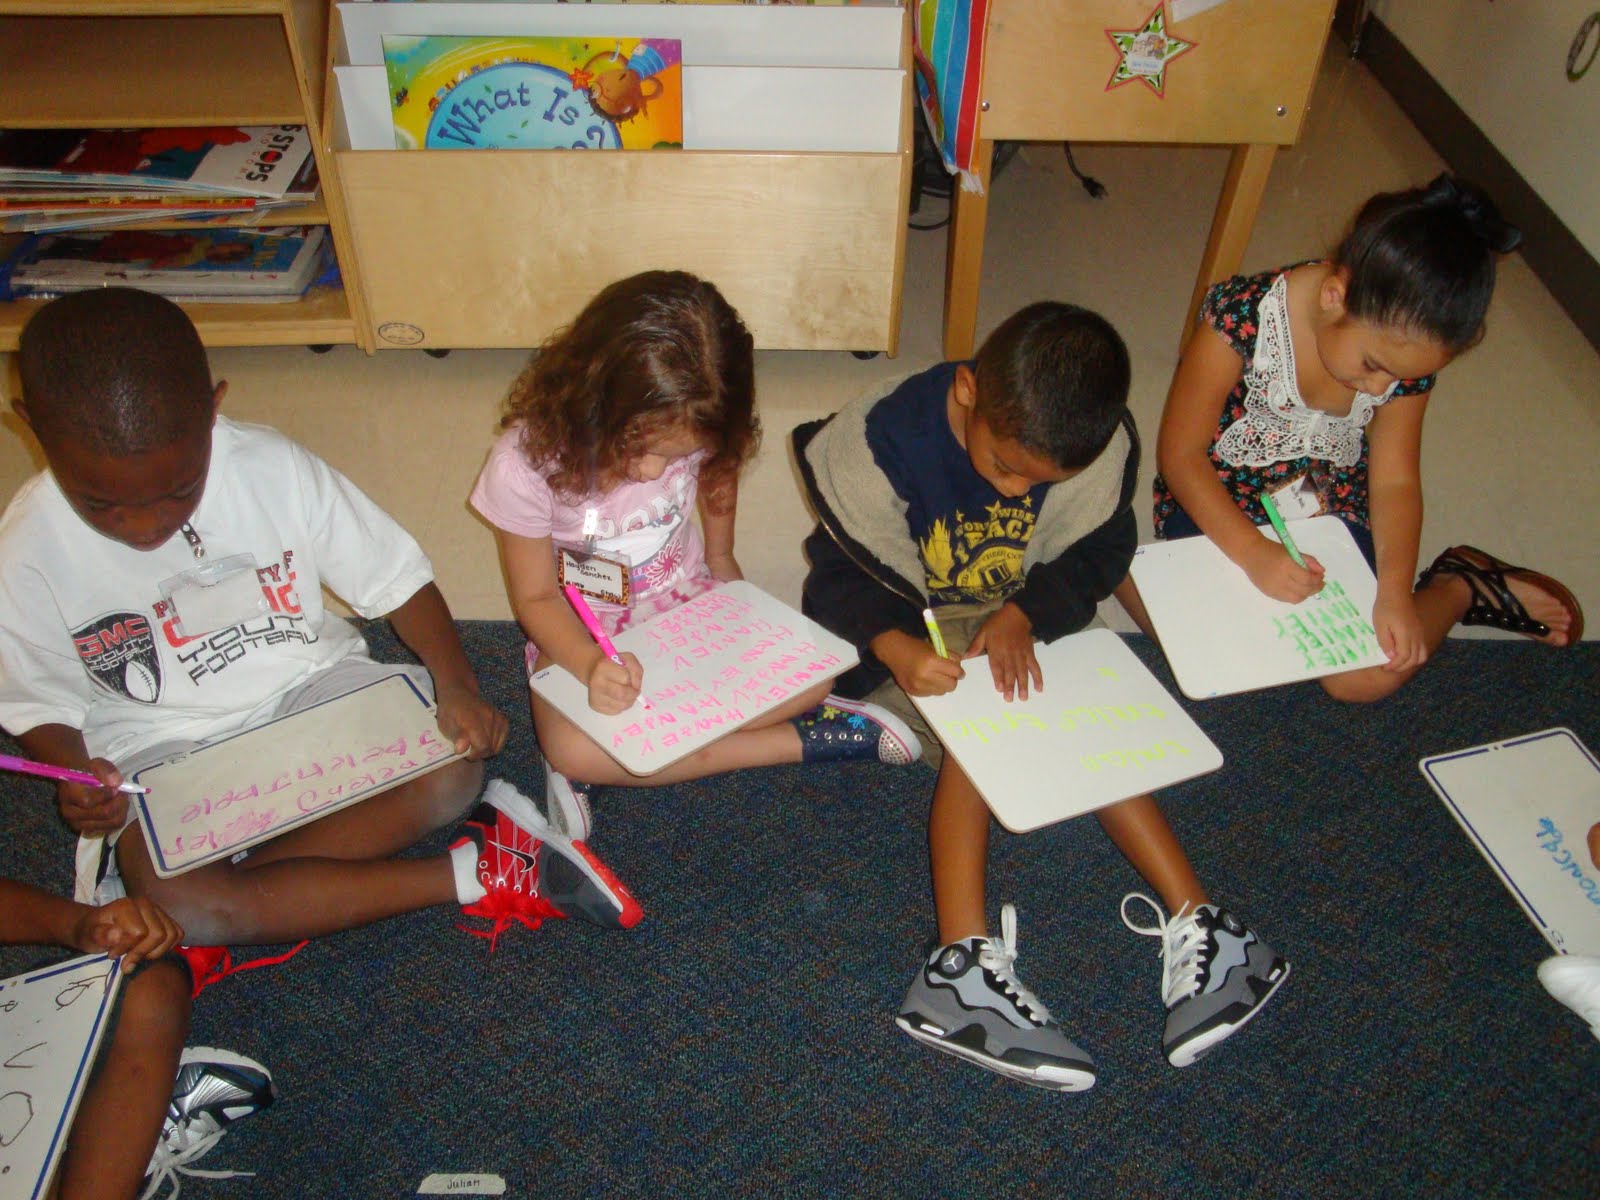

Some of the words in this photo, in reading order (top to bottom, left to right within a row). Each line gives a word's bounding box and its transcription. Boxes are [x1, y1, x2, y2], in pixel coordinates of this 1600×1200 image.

[437, 82, 531, 148] What
[542, 86, 580, 127] Is
[246, 132, 295, 183] STOPS
[73, 617, 151, 658] GMC
[176, 615, 304, 664] YOUT
[447, 1179, 480, 1189] Julian
